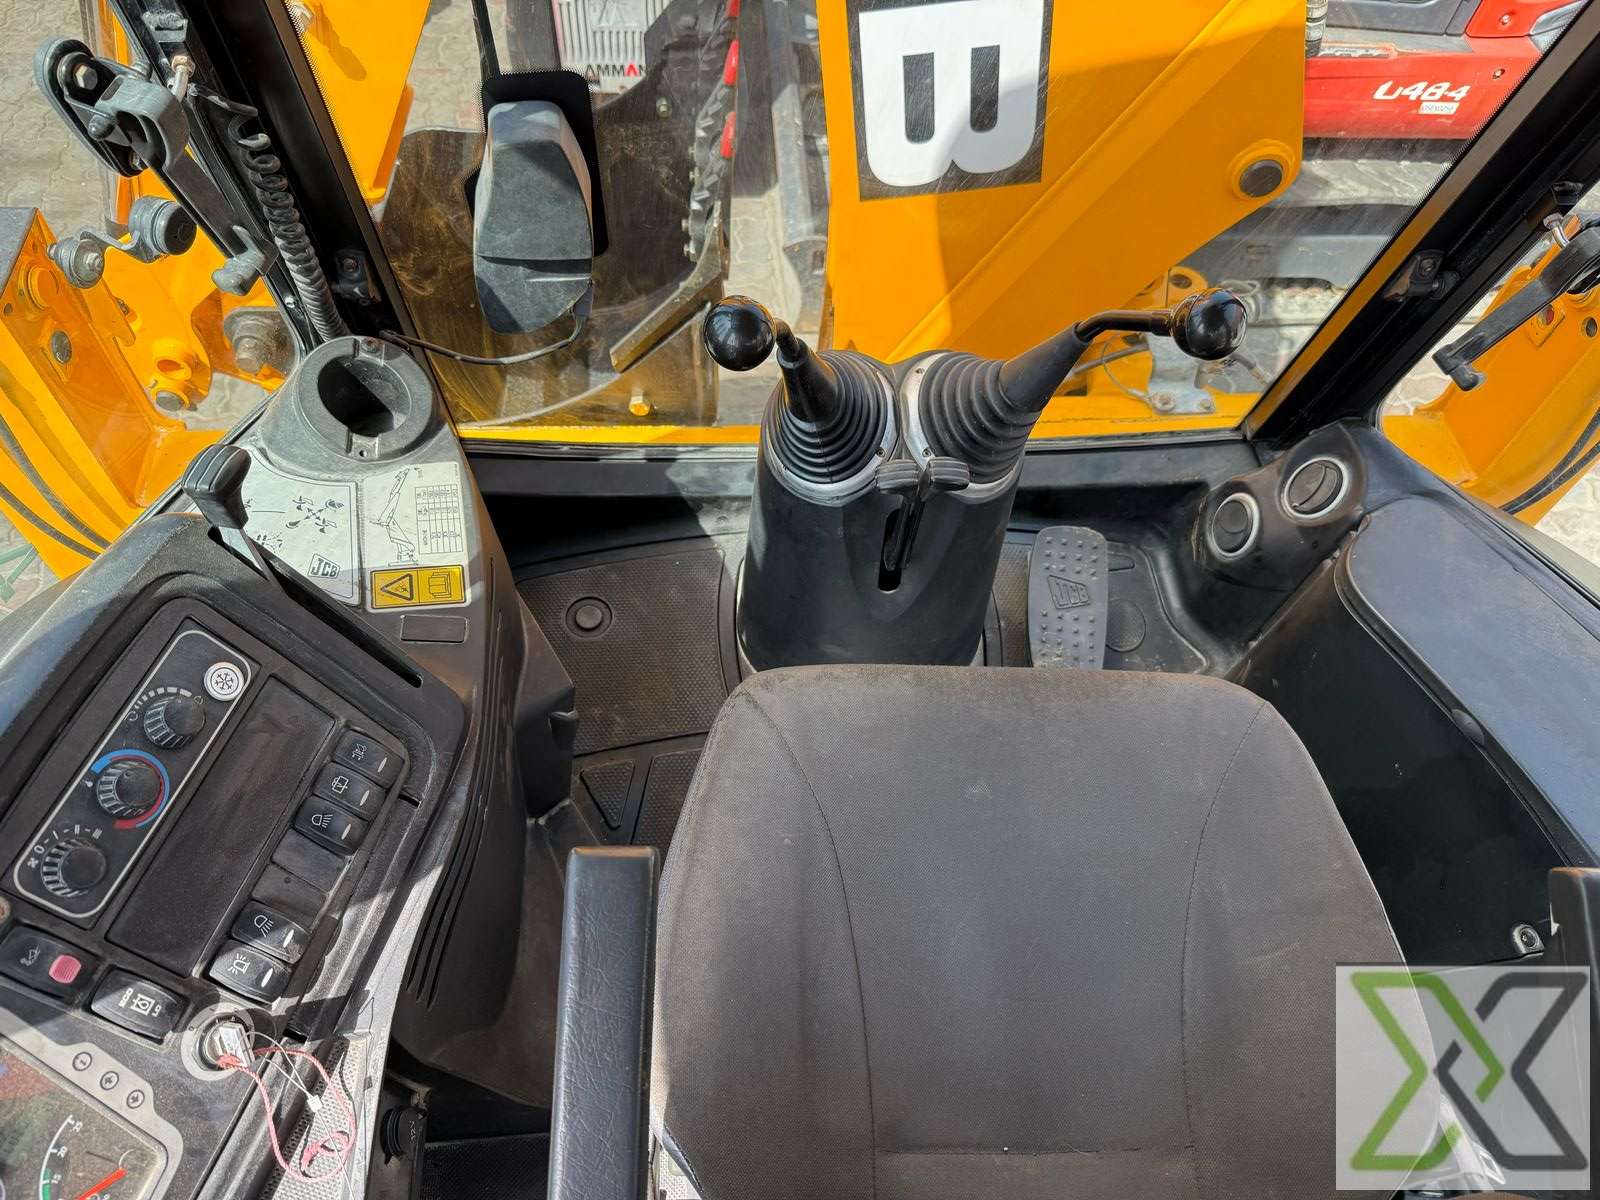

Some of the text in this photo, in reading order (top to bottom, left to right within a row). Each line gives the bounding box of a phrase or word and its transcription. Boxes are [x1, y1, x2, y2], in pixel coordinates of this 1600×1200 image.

[859, 0, 1044, 187] B
[1373, 80, 1471, 101] U48-4
[310, 557, 338, 577] JCB
